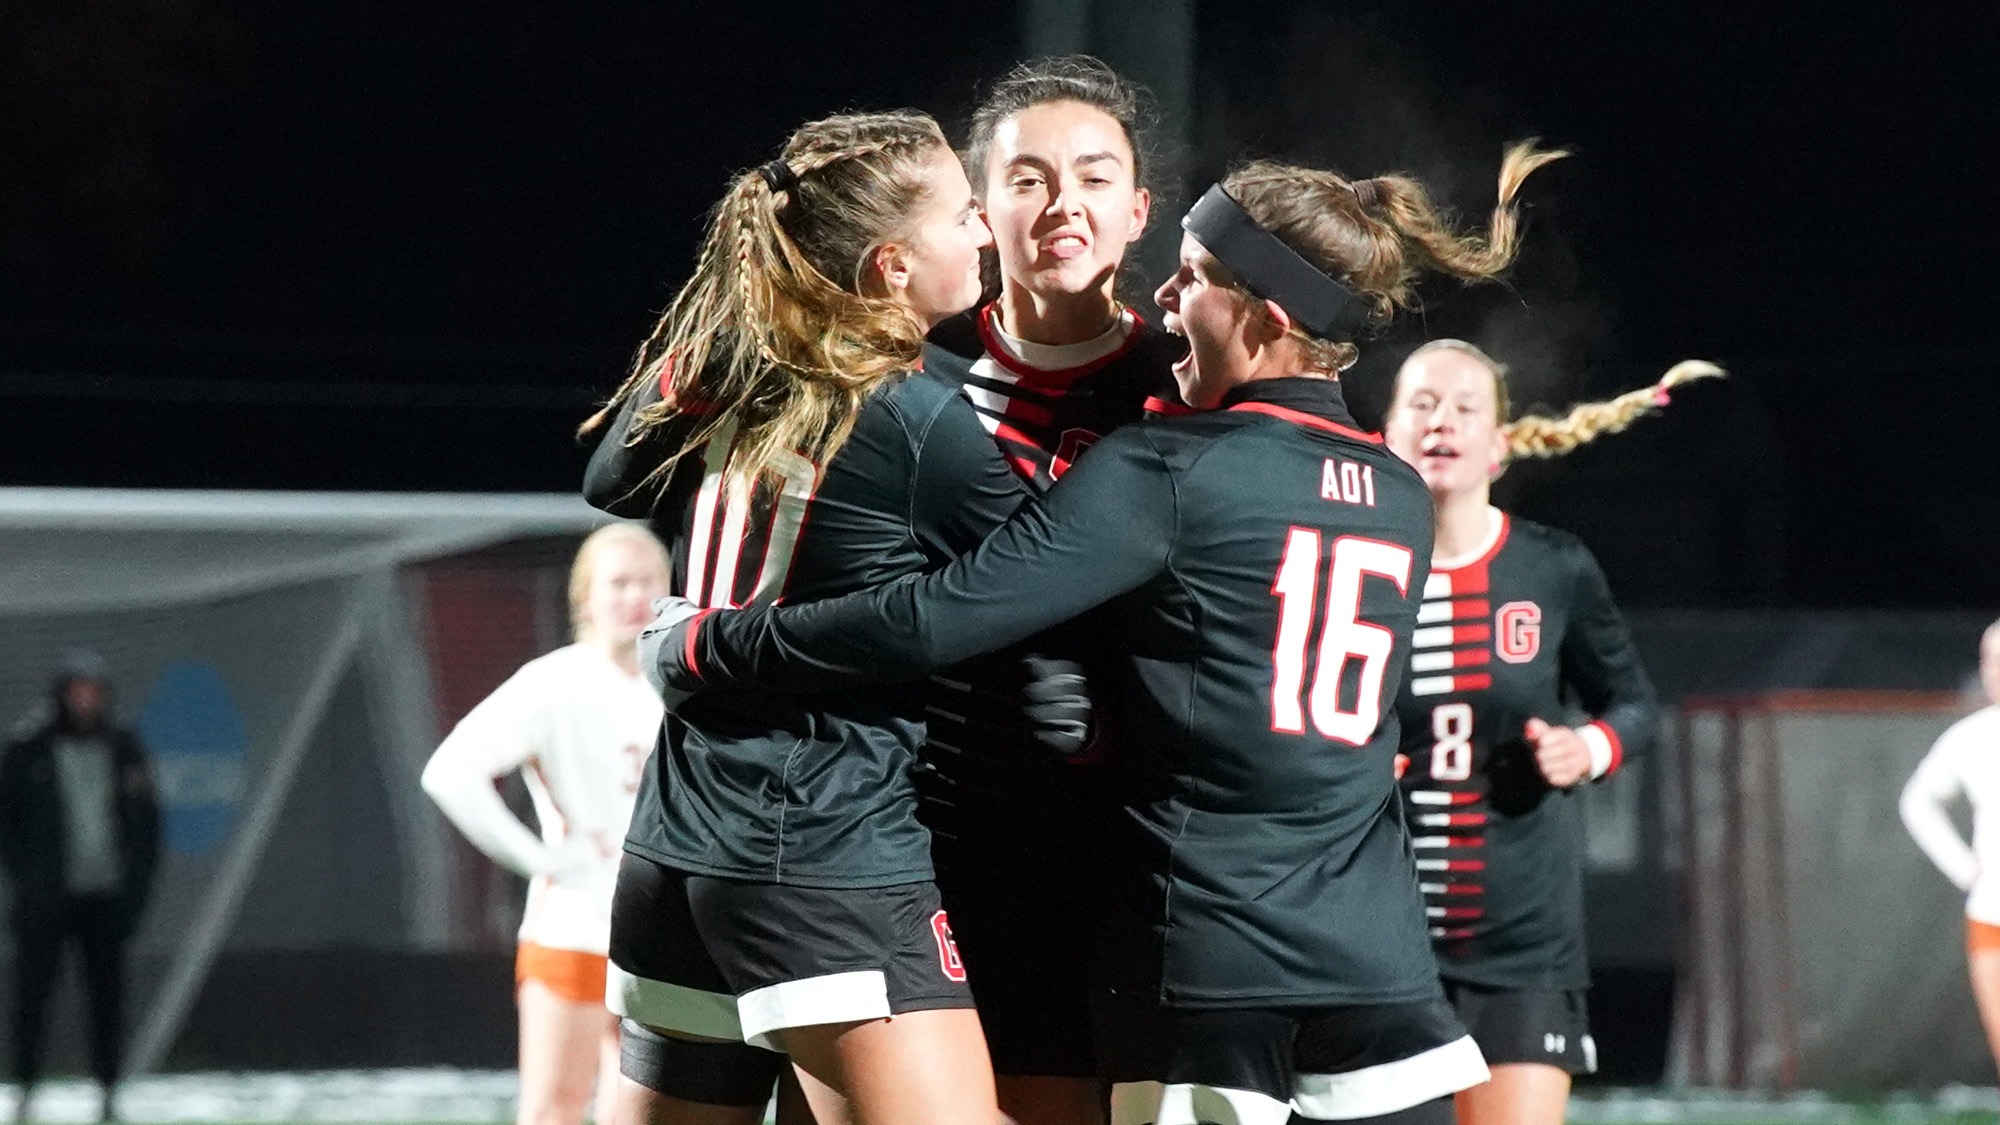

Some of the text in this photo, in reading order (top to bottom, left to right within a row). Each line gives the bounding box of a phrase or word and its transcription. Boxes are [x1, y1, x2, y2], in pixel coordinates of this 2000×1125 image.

[1270, 525, 1413, 746] 16
[1495, 600, 1541, 664] G
[1430, 702, 1473, 781] 8
